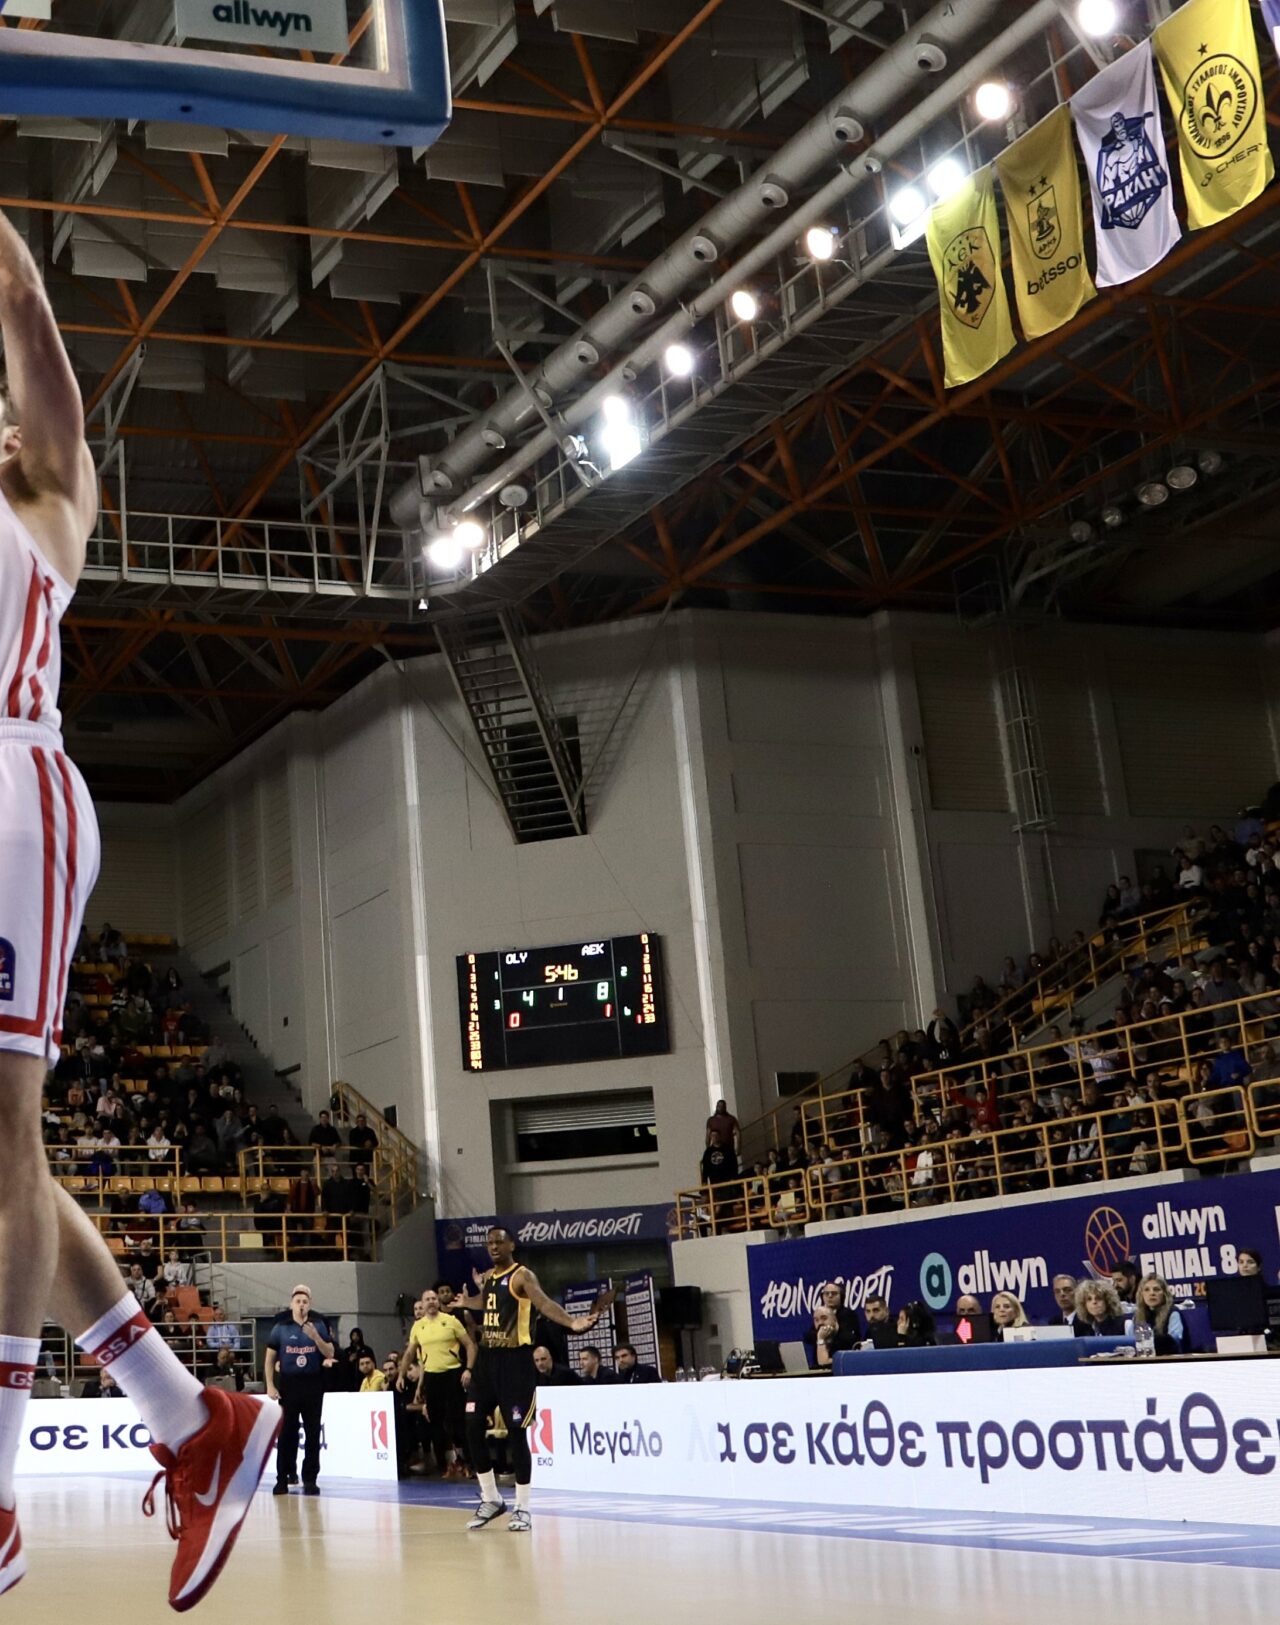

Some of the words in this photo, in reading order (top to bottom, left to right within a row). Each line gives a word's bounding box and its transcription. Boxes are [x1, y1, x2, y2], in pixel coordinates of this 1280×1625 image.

[212, 0, 312, 36] allwyn
[641, 933, 648, 944] 0
[505, 952, 528, 965] OLY
[581, 943, 605, 957] AEK
[522, 990, 534, 1007] 4
[558, 987, 564, 1001] 1
[596, 981, 609, 1000] 8
[509, 1012, 521, 1028] 0
[605, 1003, 612, 1018] 1
[1141, 1201, 1227, 1245] allwyn
[1139, 1246, 1217, 1280] FINAL
[1220, 1244, 1239, 1275] 8
[957, 1250, 1049, 1302] allwyn
[486, 1293, 497, 1310] 21
[483, 1312, 500, 1327] AEK
[98, 1323, 147, 1367] GSA
[30, 1425, 88, 1451] σε
[568, 1419, 663, 1464] Μεγάλο
[744, 1422, 797, 1464] σε
[805, 1400, 927, 1468] κάθε
[935, 1390, 1280, 1484] προσπάθε
[537, 1457, 554, 1467] EKO
